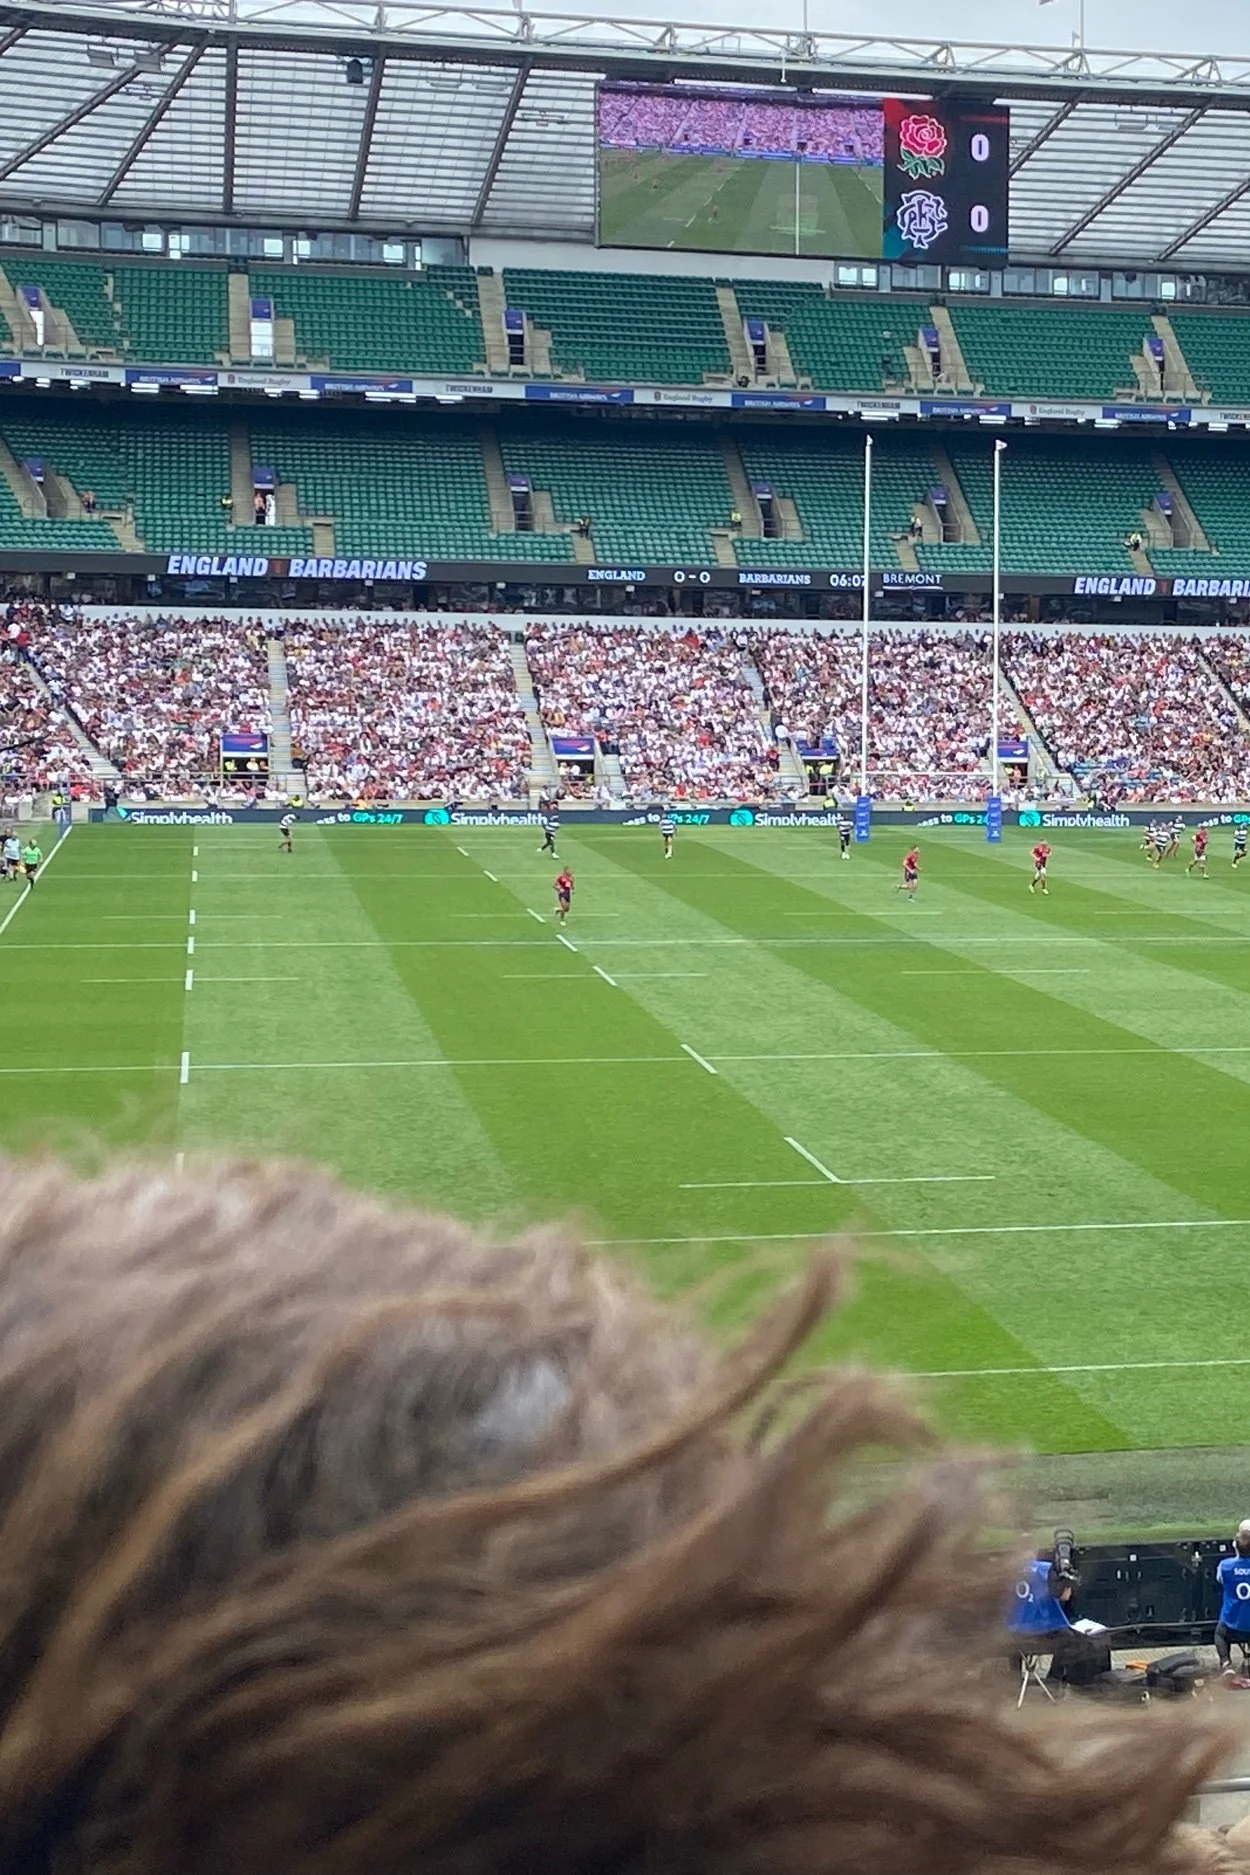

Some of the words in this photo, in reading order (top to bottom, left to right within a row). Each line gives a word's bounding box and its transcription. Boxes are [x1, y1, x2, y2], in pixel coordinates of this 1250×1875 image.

[970, 133, 990, 162] 0
[970, 205, 989, 233] 0
[445, 384, 493, 393] TWICKENHAM
[167, 556, 268, 576] ENGLAND
[289, 558, 427, 580] BARBARIANS
[588, 569, 646, 581] ENGLAND
[739, 573, 811, 585] BARBARIANS
[882, 573, 943, 585] BREMONT
[1074, 577, 1156, 595] ENGLAND
[338, 812, 352, 822] to
[353, 812, 376, 824] GPs
[377, 813, 403, 825] 24/7
[647, 813, 660, 823] to
[685, 814, 710, 825] 24/7
[941, 813, 953, 823] to
[954, 814, 976, 825] GPs
[1220, 814, 1232, 824] to
